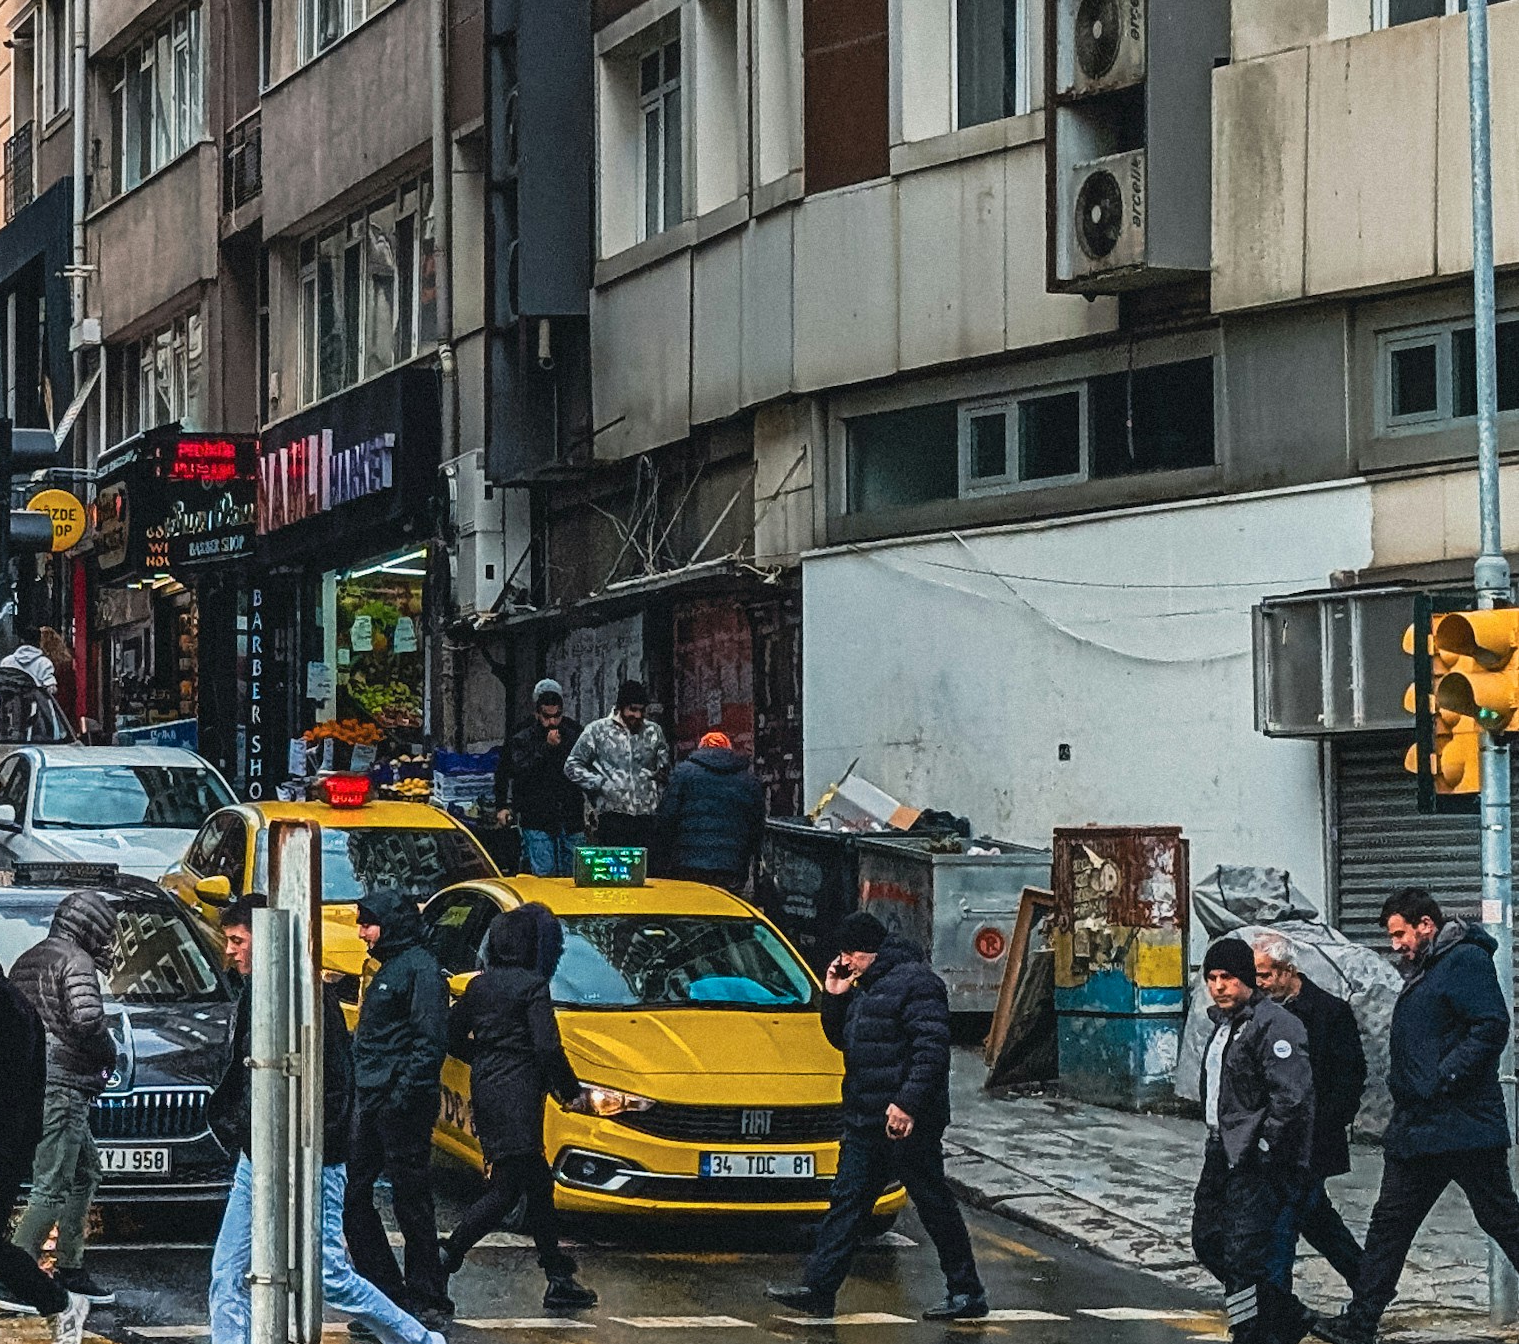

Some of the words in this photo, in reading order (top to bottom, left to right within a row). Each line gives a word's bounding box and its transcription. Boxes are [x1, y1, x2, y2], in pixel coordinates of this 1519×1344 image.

[251, 589, 263, 724] BARBER
[249, 735, 263, 799] SHO
[741, 1110, 774, 1135] FIAT
[133, 1151, 164, 1170] 958
[713, 1156, 732, 1174] 34
[746, 1156, 776, 1174] TDC
[793, 1156, 811, 1174] 81
